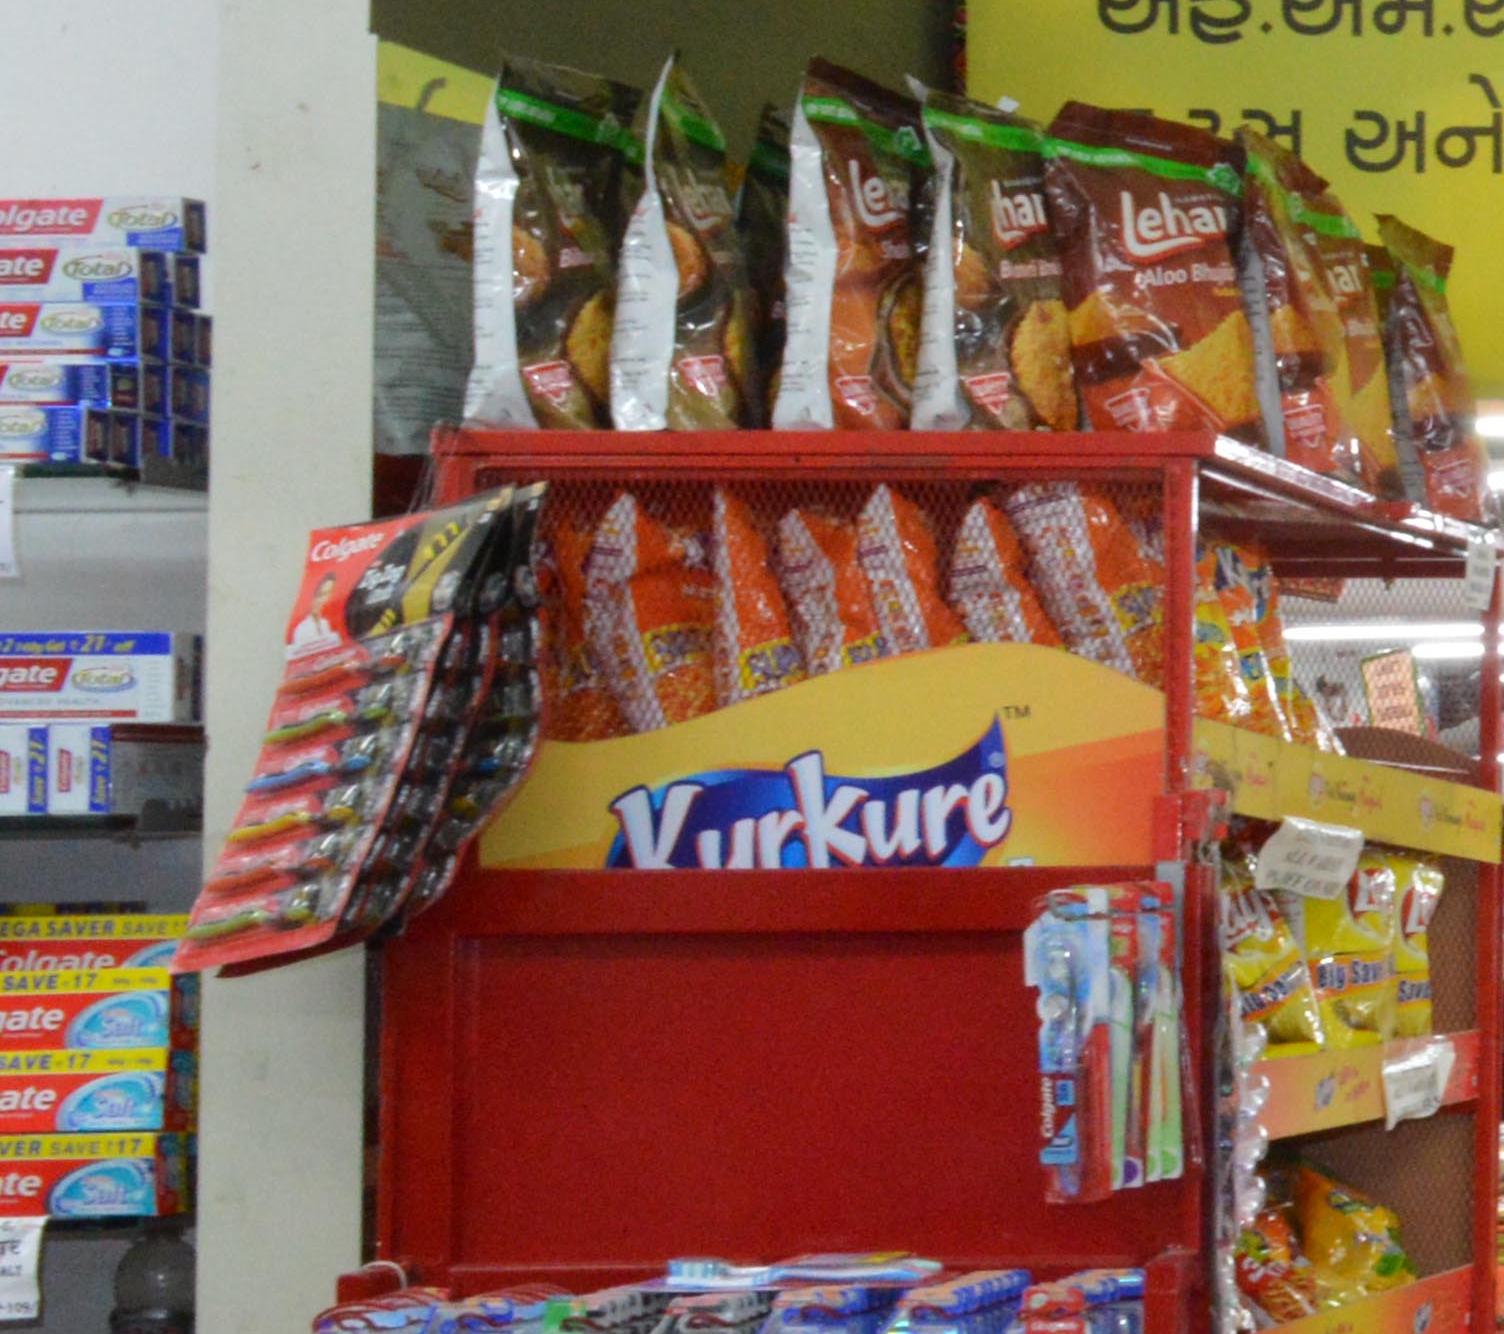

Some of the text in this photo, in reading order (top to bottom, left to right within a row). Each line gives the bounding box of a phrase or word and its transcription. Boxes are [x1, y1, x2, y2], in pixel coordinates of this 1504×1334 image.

[1345, 74, 1503, 174] અને
[1143, 266, 1188, 286] Aloo
[310, 531, 385, 564] Colgate
[609, 750, 1012, 868] Kurkure
[48, 919, 115, 937] SAVER
[3, 974, 58, 990] SAVE
[50, 1140, 100, 1156] SAVE
